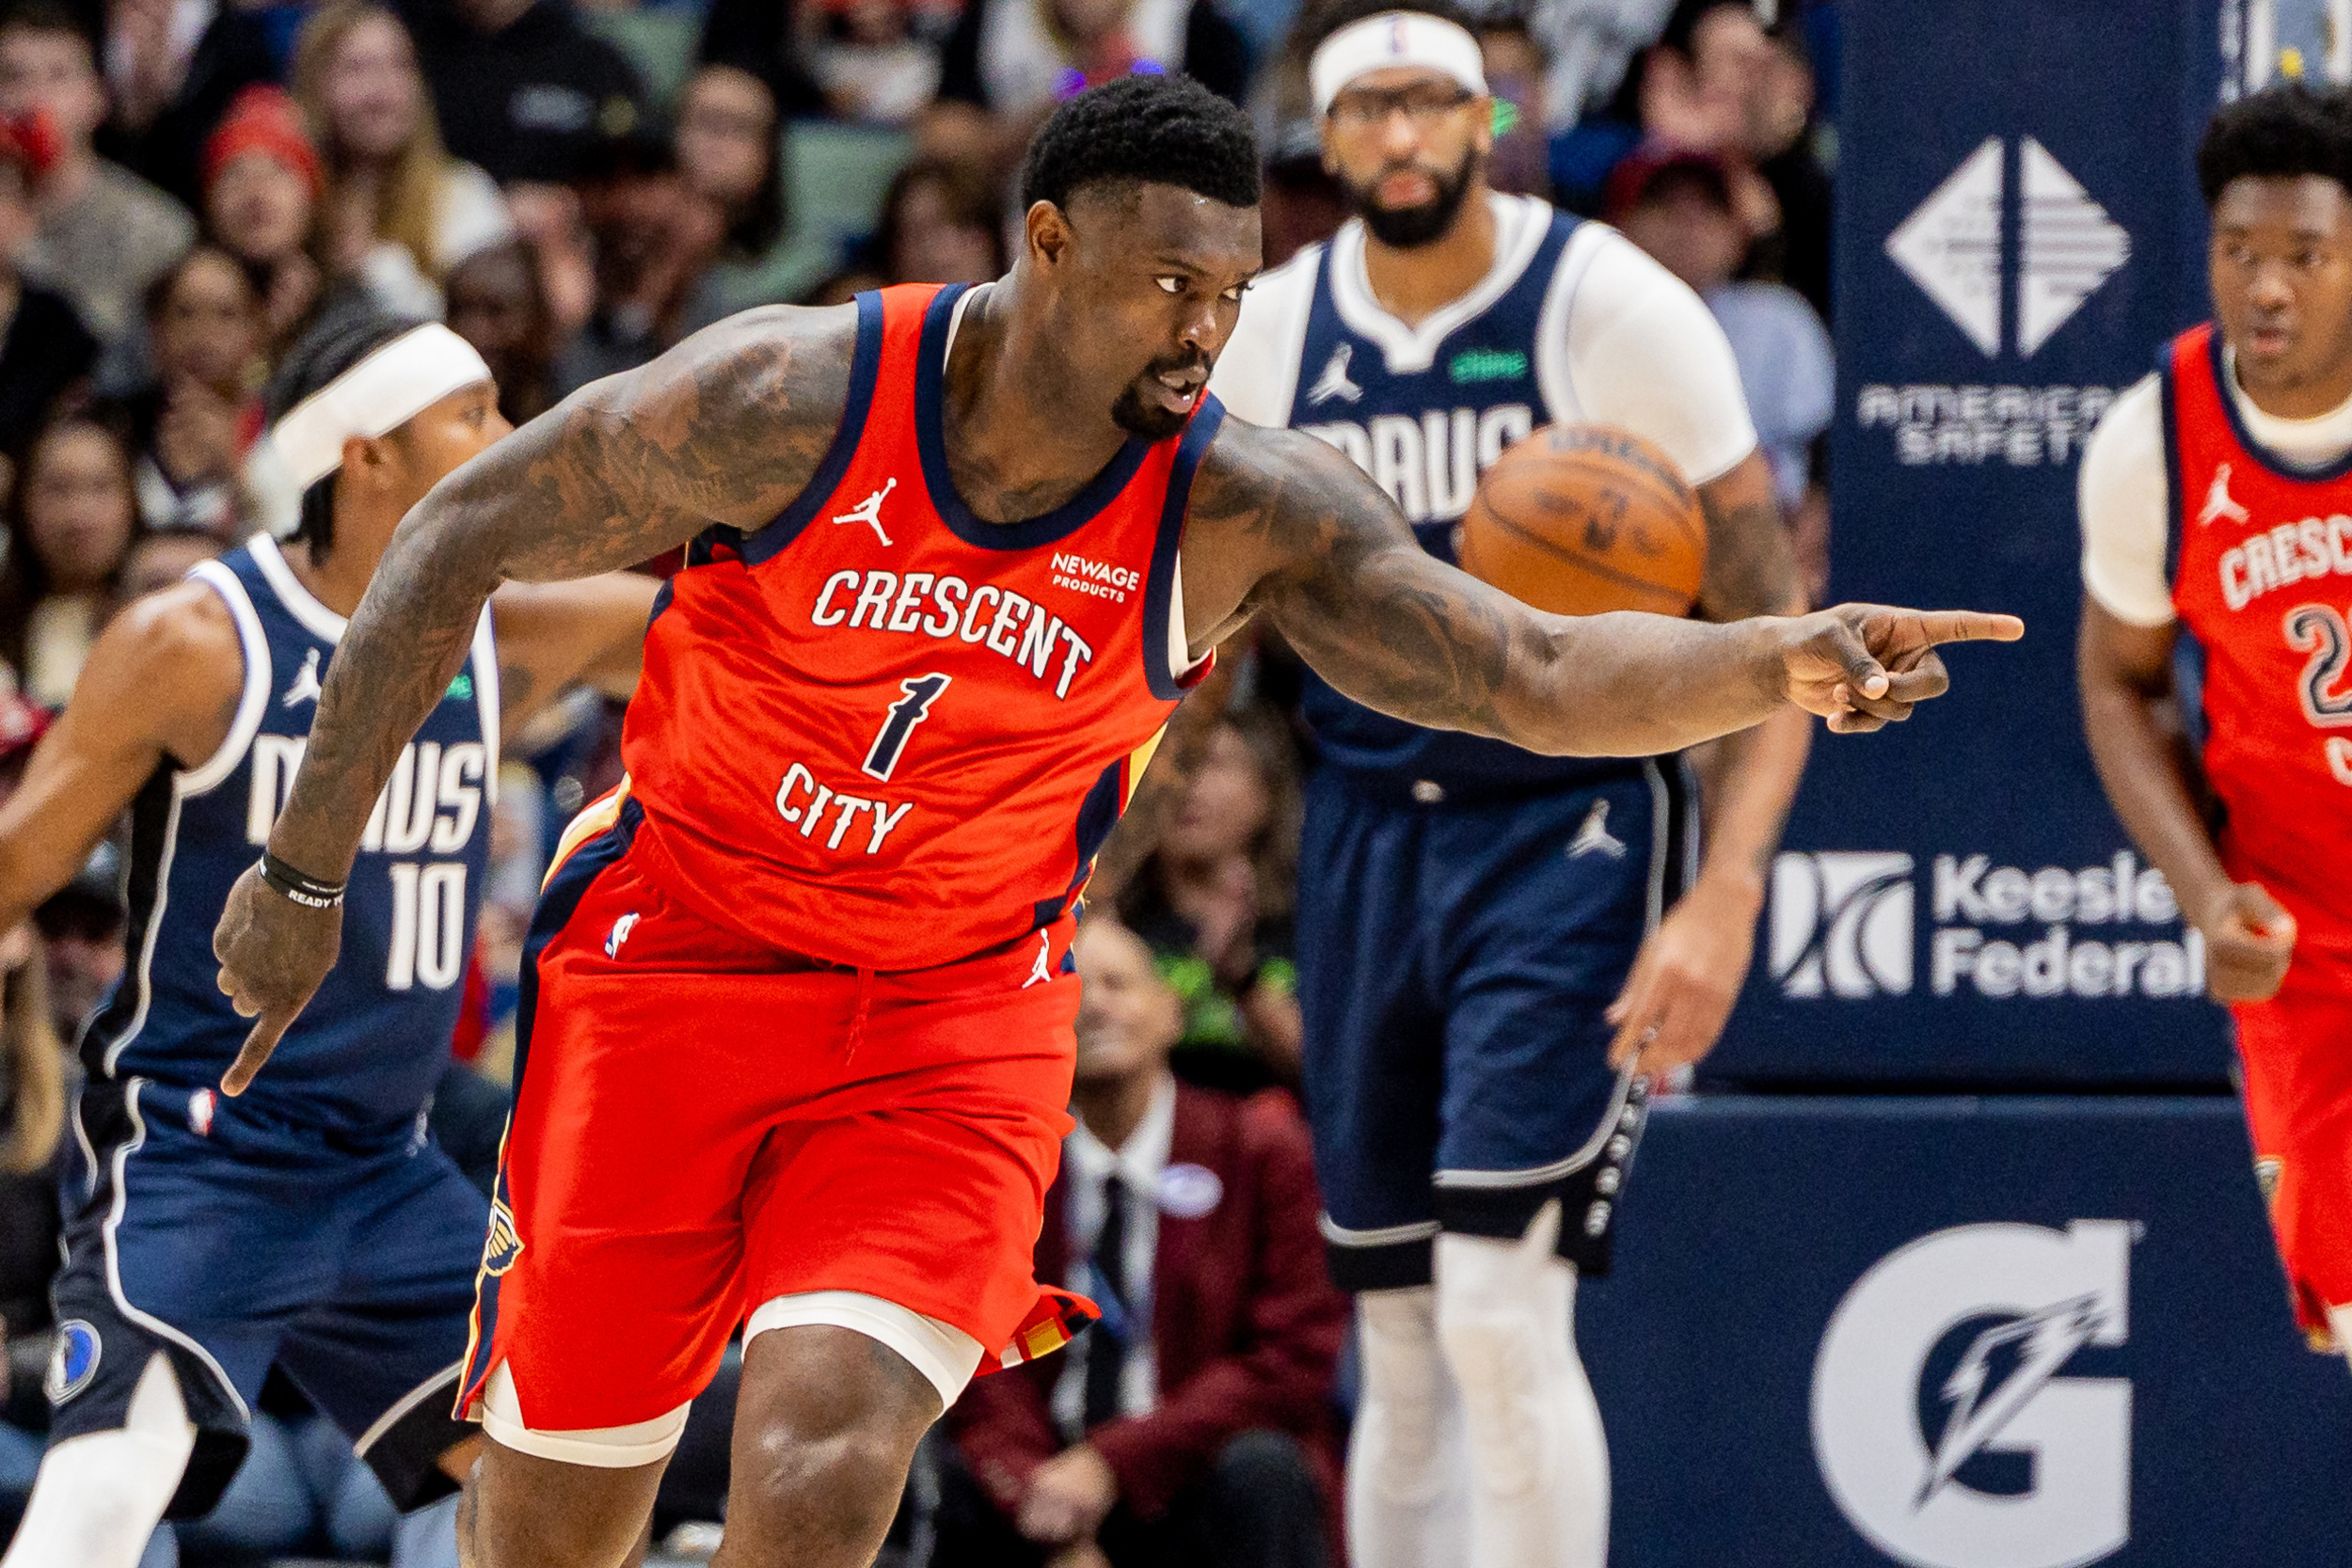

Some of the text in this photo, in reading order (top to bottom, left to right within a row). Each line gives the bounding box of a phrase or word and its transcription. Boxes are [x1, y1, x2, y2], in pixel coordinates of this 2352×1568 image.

[1856, 384, 2121, 428] AMERICA
[1895, 423, 2086, 467] SAFET
[1050, 551, 1140, 592] NEWAGE
[1053, 574, 1125, 604] PRODUCTS
[2218, 514, 2352, 611] CRESC
[811, 570, 1093, 701] CRESCENT
[2282, 602, 2352, 729] 2
[862, 673, 952, 783] 1
[775, 762, 914, 855] CITY
[288, 889, 331, 909] READY
[384, 862, 468, 990] 10
[1931, 848, 2179, 925] Keesle
[1931, 924, 2205, 998] Federal
[1810, 1218, 2133, 1568] G
